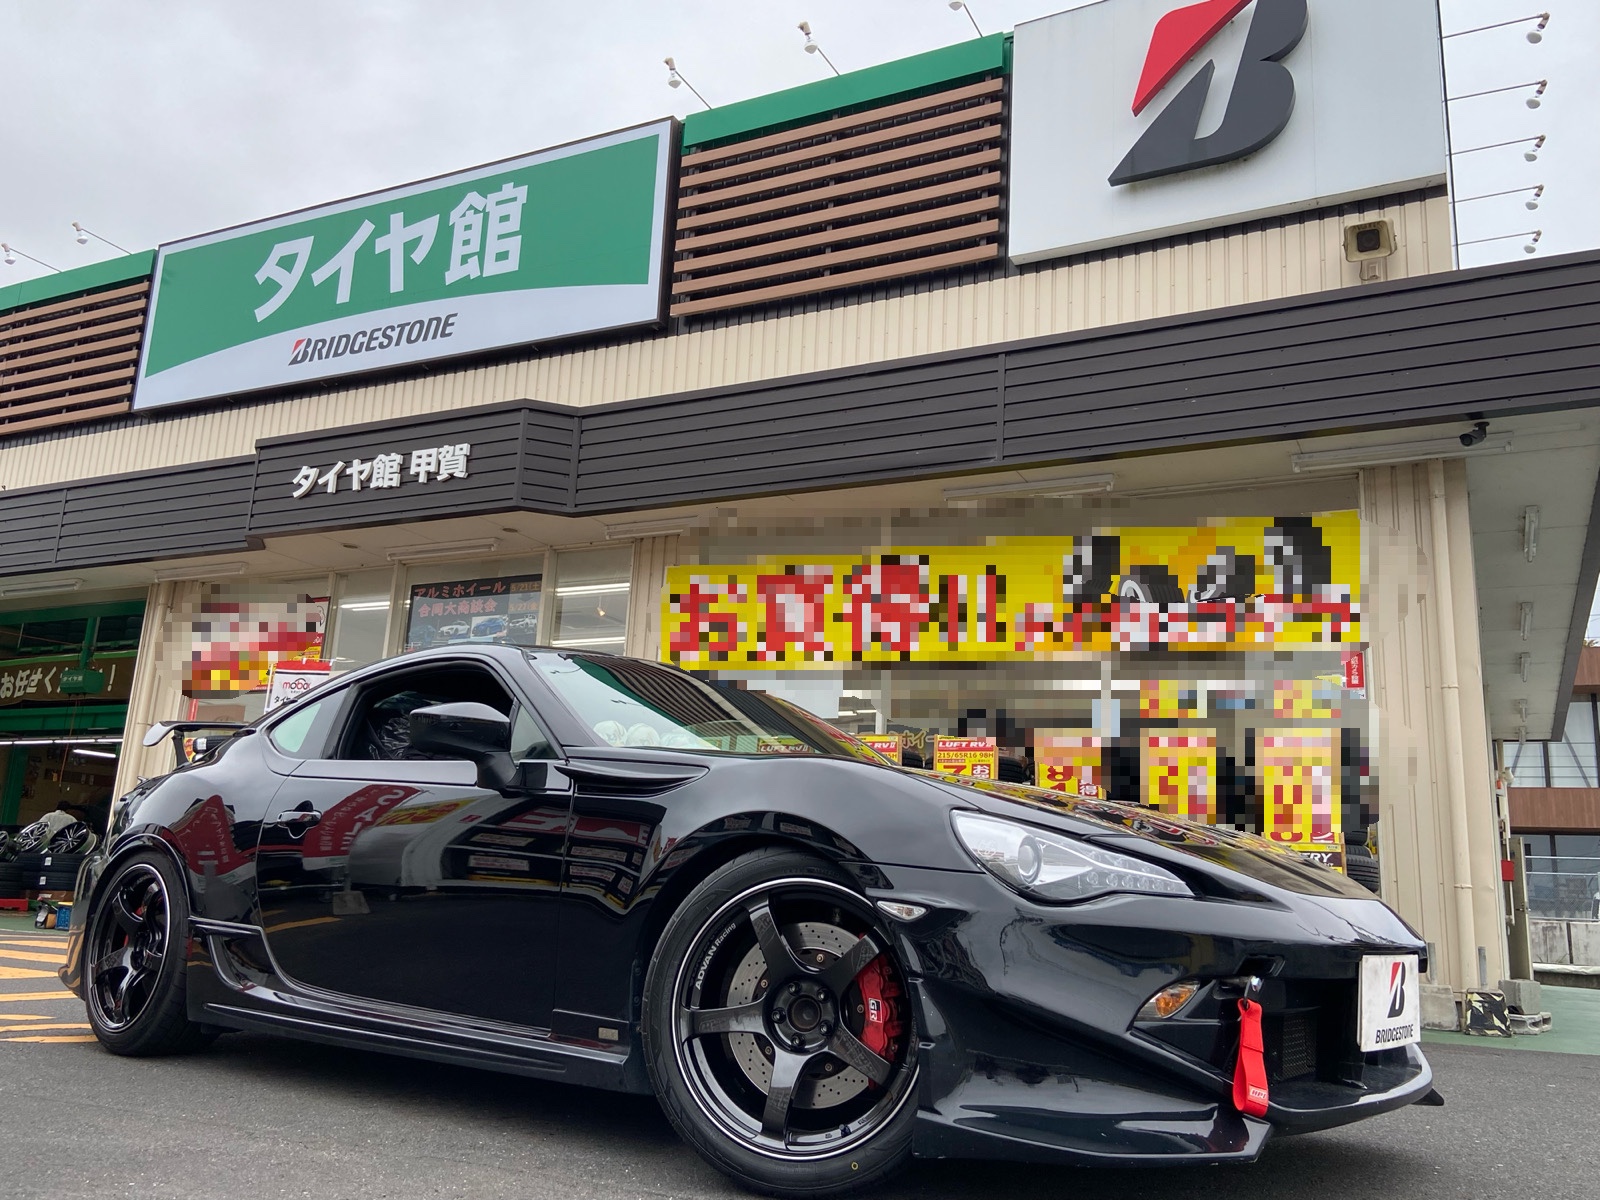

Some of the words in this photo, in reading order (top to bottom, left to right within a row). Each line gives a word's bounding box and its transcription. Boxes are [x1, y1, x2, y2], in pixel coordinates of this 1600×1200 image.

[254, 182, 528, 323] タイヤ館
[288, 312, 458, 366] BRIDGESTONE
[292, 452, 403, 498] タイヤ館
[410, 443, 470, 483] 甲賀
[414, 582, 506, 599] アルミホイール
[695, 945, 717, 991] ADVAN
[714, 922, 737, 947] Racing
[1375, 1023, 1414, 1044] BRIDGESTONE
